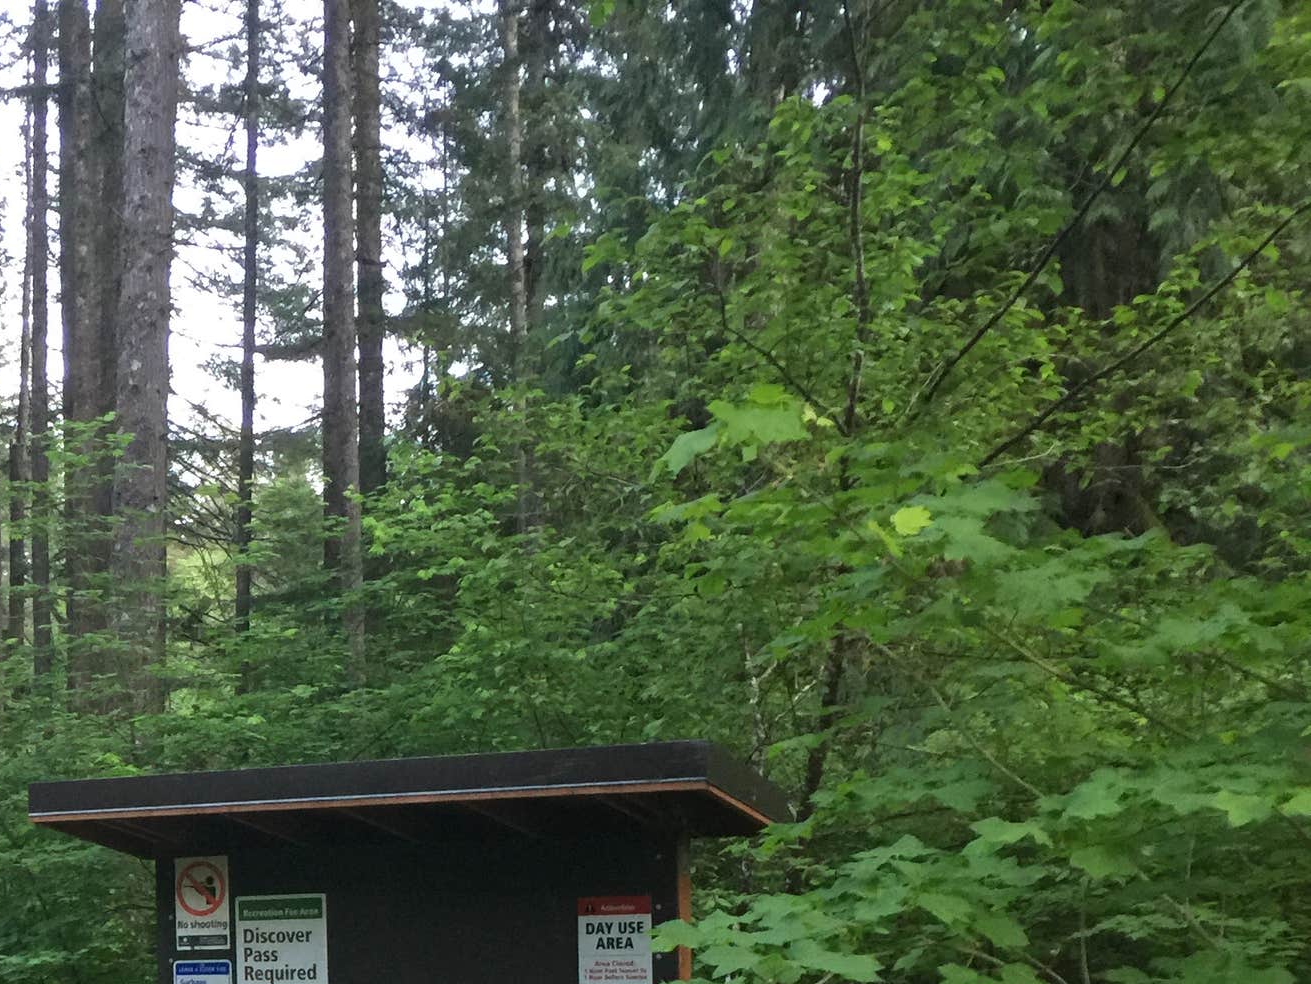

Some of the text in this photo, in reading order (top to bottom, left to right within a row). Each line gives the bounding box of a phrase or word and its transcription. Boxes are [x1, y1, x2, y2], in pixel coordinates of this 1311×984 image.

[177, 919, 228, 930] No shooting
[585, 921, 644, 935] DAY USE
[243, 927, 312, 944] Discover
[596, 937, 634, 950] AREA
[244, 947, 278, 962] Pass
[244, 963, 317, 984] Required
